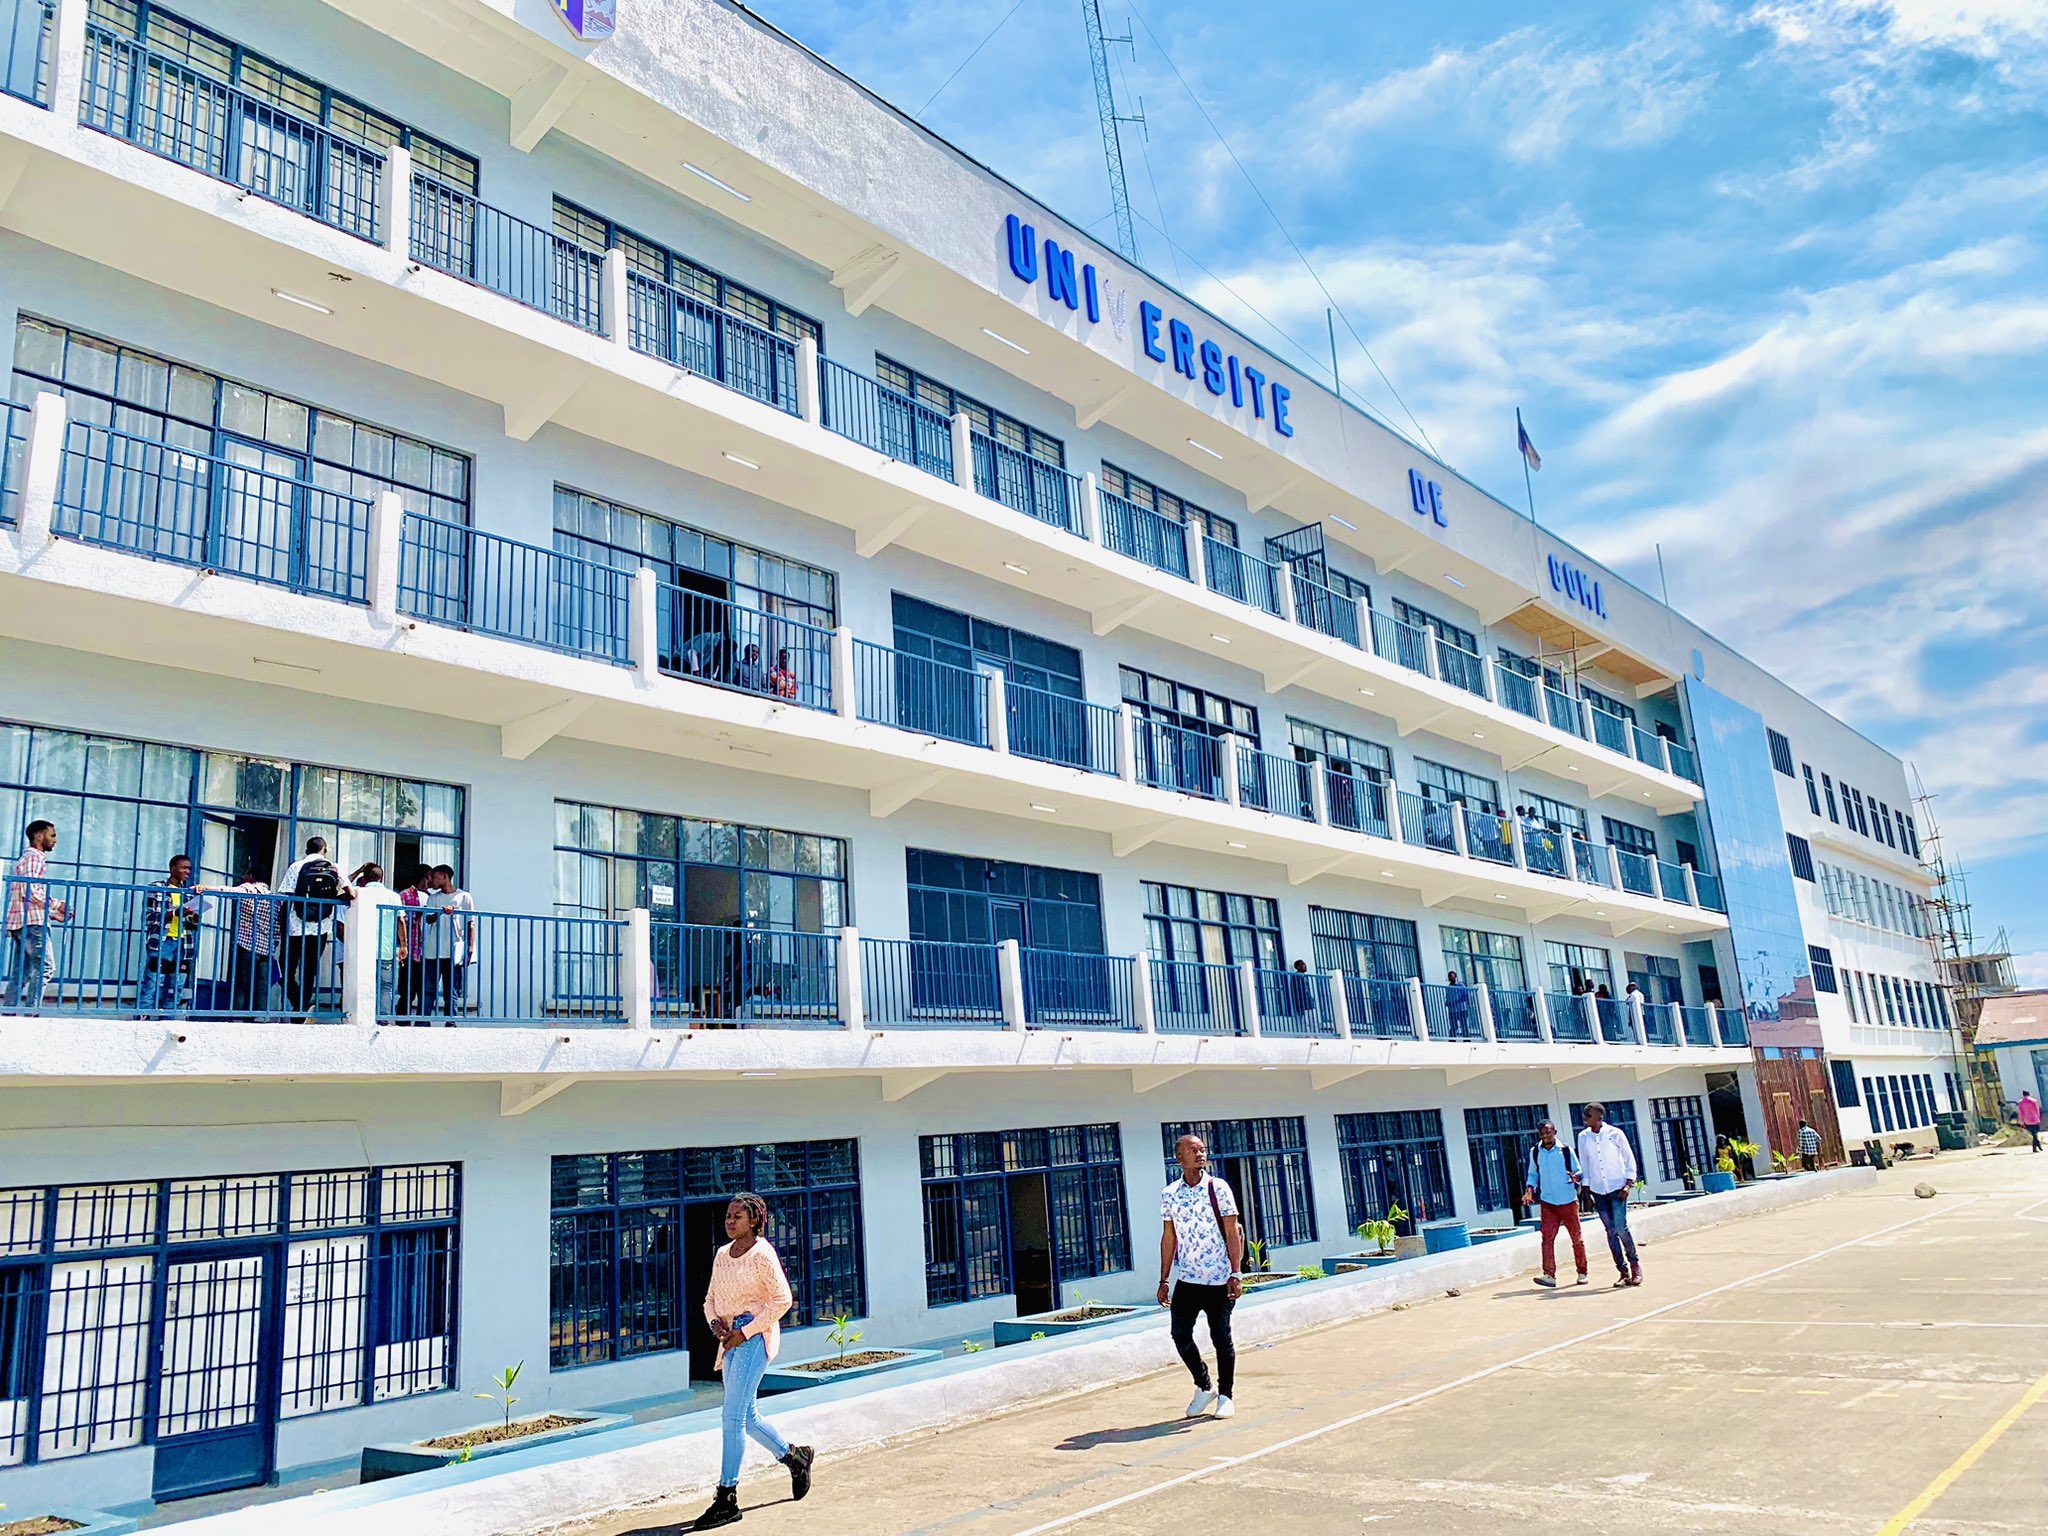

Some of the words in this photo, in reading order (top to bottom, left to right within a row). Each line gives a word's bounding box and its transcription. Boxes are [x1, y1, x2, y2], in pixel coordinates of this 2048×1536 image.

[1006, 213, 1294, 438] UNIVERSITE
[1408, 467, 1448, 528] DE
[293, 1292, 311, 1300] SALE
